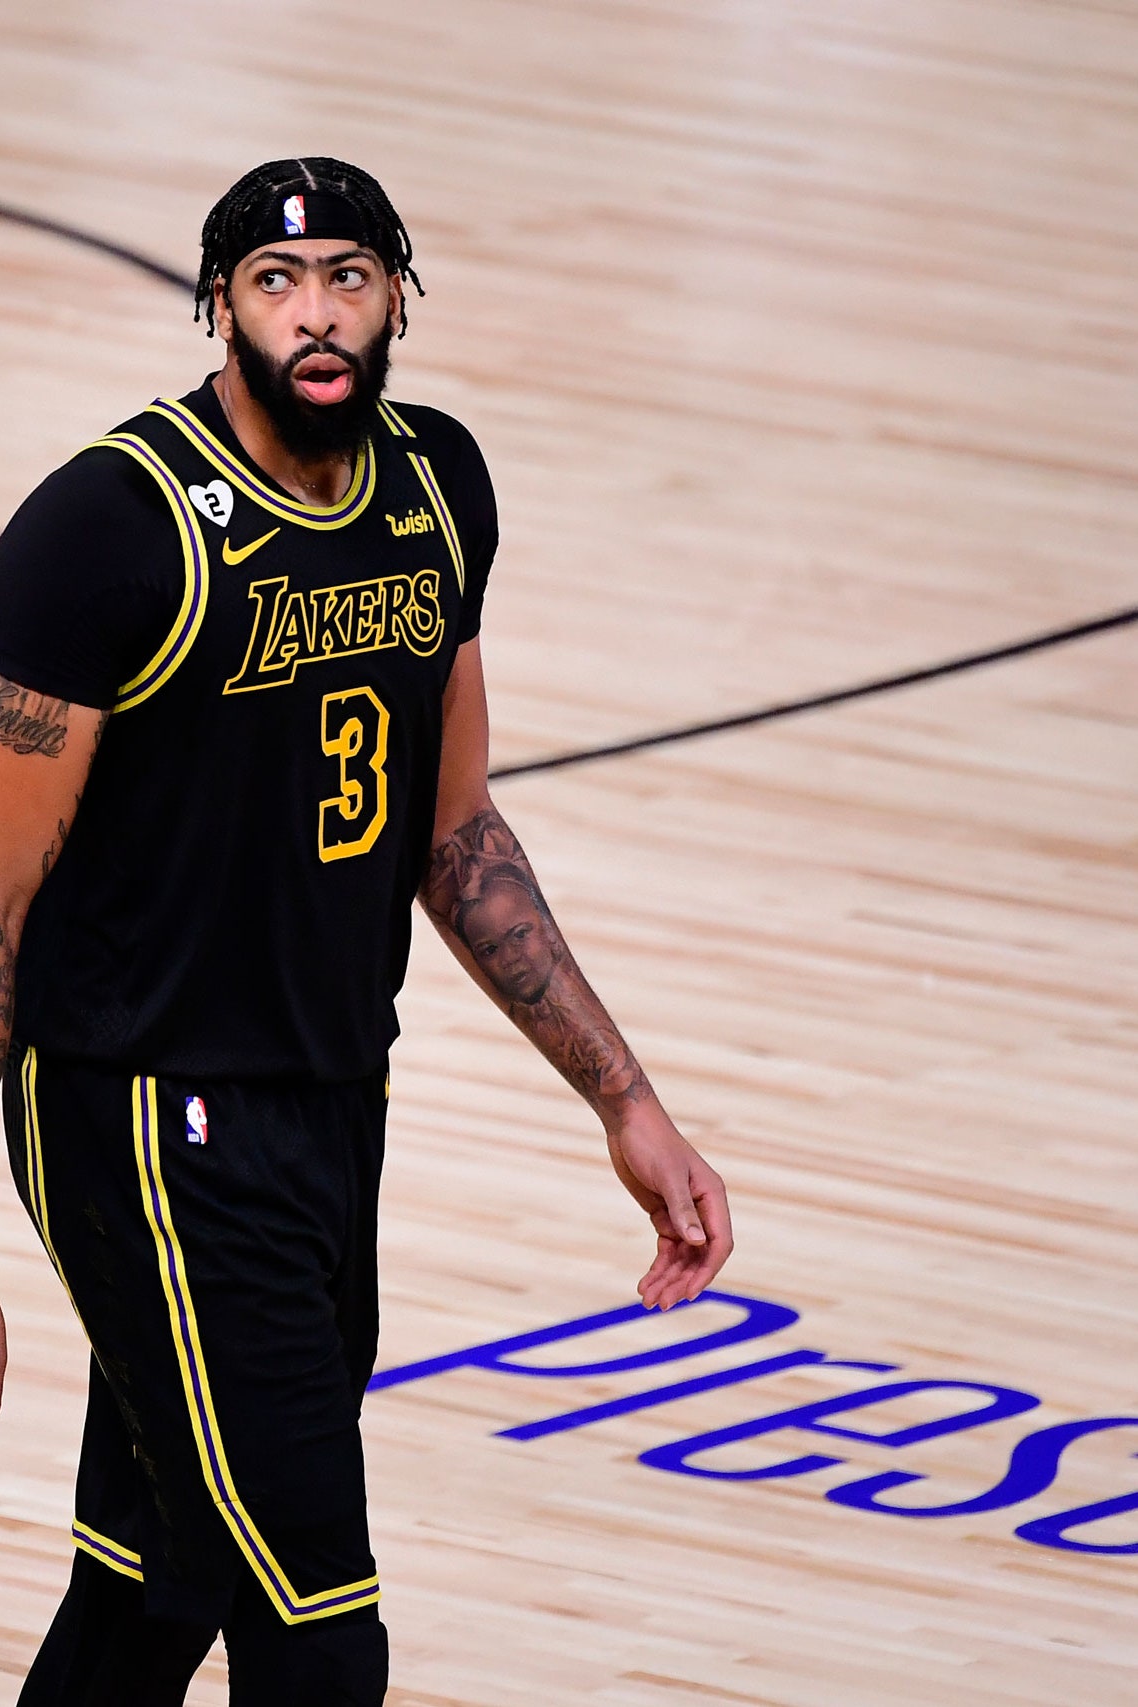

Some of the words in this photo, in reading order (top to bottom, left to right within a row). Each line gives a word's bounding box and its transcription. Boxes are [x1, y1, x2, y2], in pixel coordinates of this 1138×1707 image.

[204, 493, 226, 517] 2
[385, 507, 435, 537] wish
[222, 569, 445, 696] LAKERS
[318, 686, 390, 863] 3
